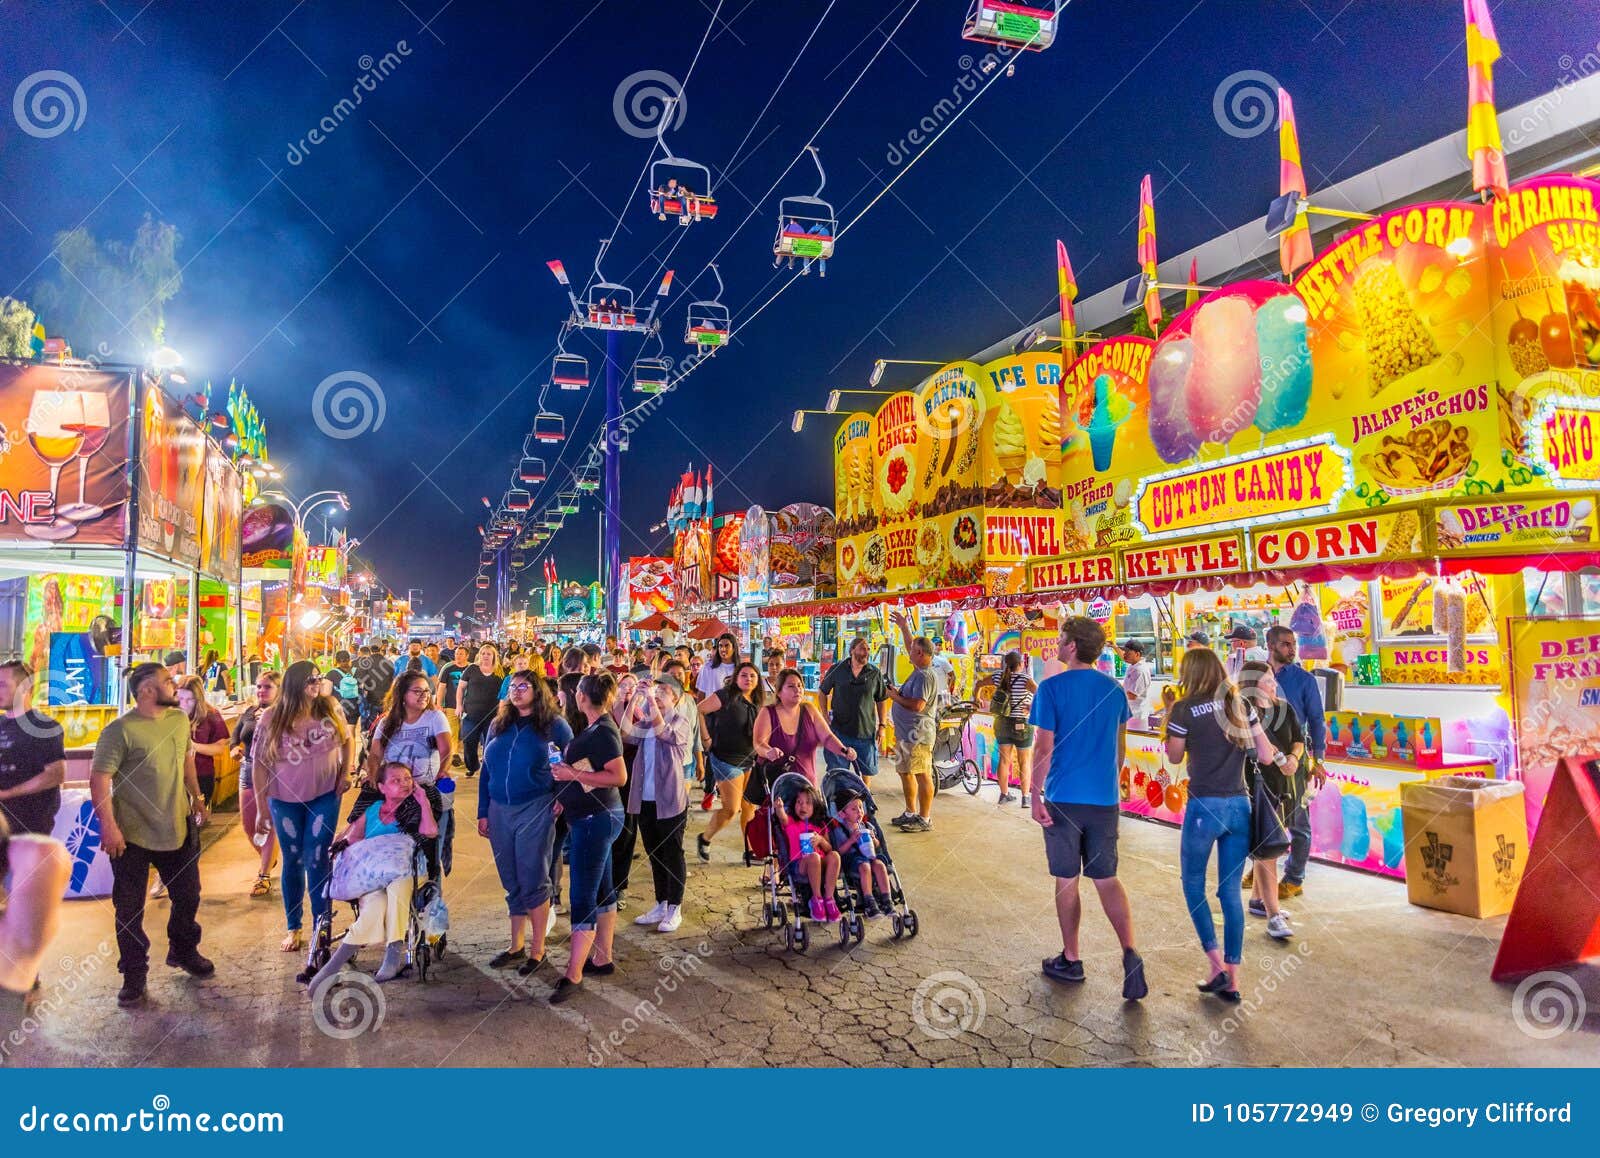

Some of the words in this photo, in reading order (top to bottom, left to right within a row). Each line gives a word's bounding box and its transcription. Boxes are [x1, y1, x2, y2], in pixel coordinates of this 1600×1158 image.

[1493, 186, 1598, 249] CARAMEL
[1546, 222, 1600, 255] SLIC
[1295, 223, 1383, 320] KETTLE
[1387, 208, 1475, 248] CORN
[935, 367, 964, 389] FROZEN
[991, 366, 1026, 392] ICE
[1064, 342, 1152, 408] SNO-CONES
[925, 381, 976, 416] BANANA
[1410, 384, 1489, 429] NACHOS
[878, 396, 916, 437] FUNNEL
[837, 430, 846, 454] ICE
[848, 420, 869, 440] CREAM
[878, 424, 918, 457] CAKES
[1546, 413, 1592, 471] SNO
[1067, 476, 1096, 500] DEEP
[1082, 482, 1114, 507] FRIED
[1152, 471, 1226, 528] COTTON
[1234, 449, 1323, 502] CANDY
[1457, 504, 1525, 531] DEEP
[1502, 501, 1570, 533] FRIED
[885, 529, 917, 551] TEXAS
[987, 516, 1060, 556] FUNNEL
[1463, 532, 1500, 543] SNICKERS
[886, 548, 916, 571] SIZE
[1033, 556, 1113, 589] KILLER
[1126, 539, 1239, 579] KETTLE
[1258, 520, 1378, 565] CORN
[1332, 608, 1359, 621] DEEP
[1338, 618, 1363, 631] RIED
